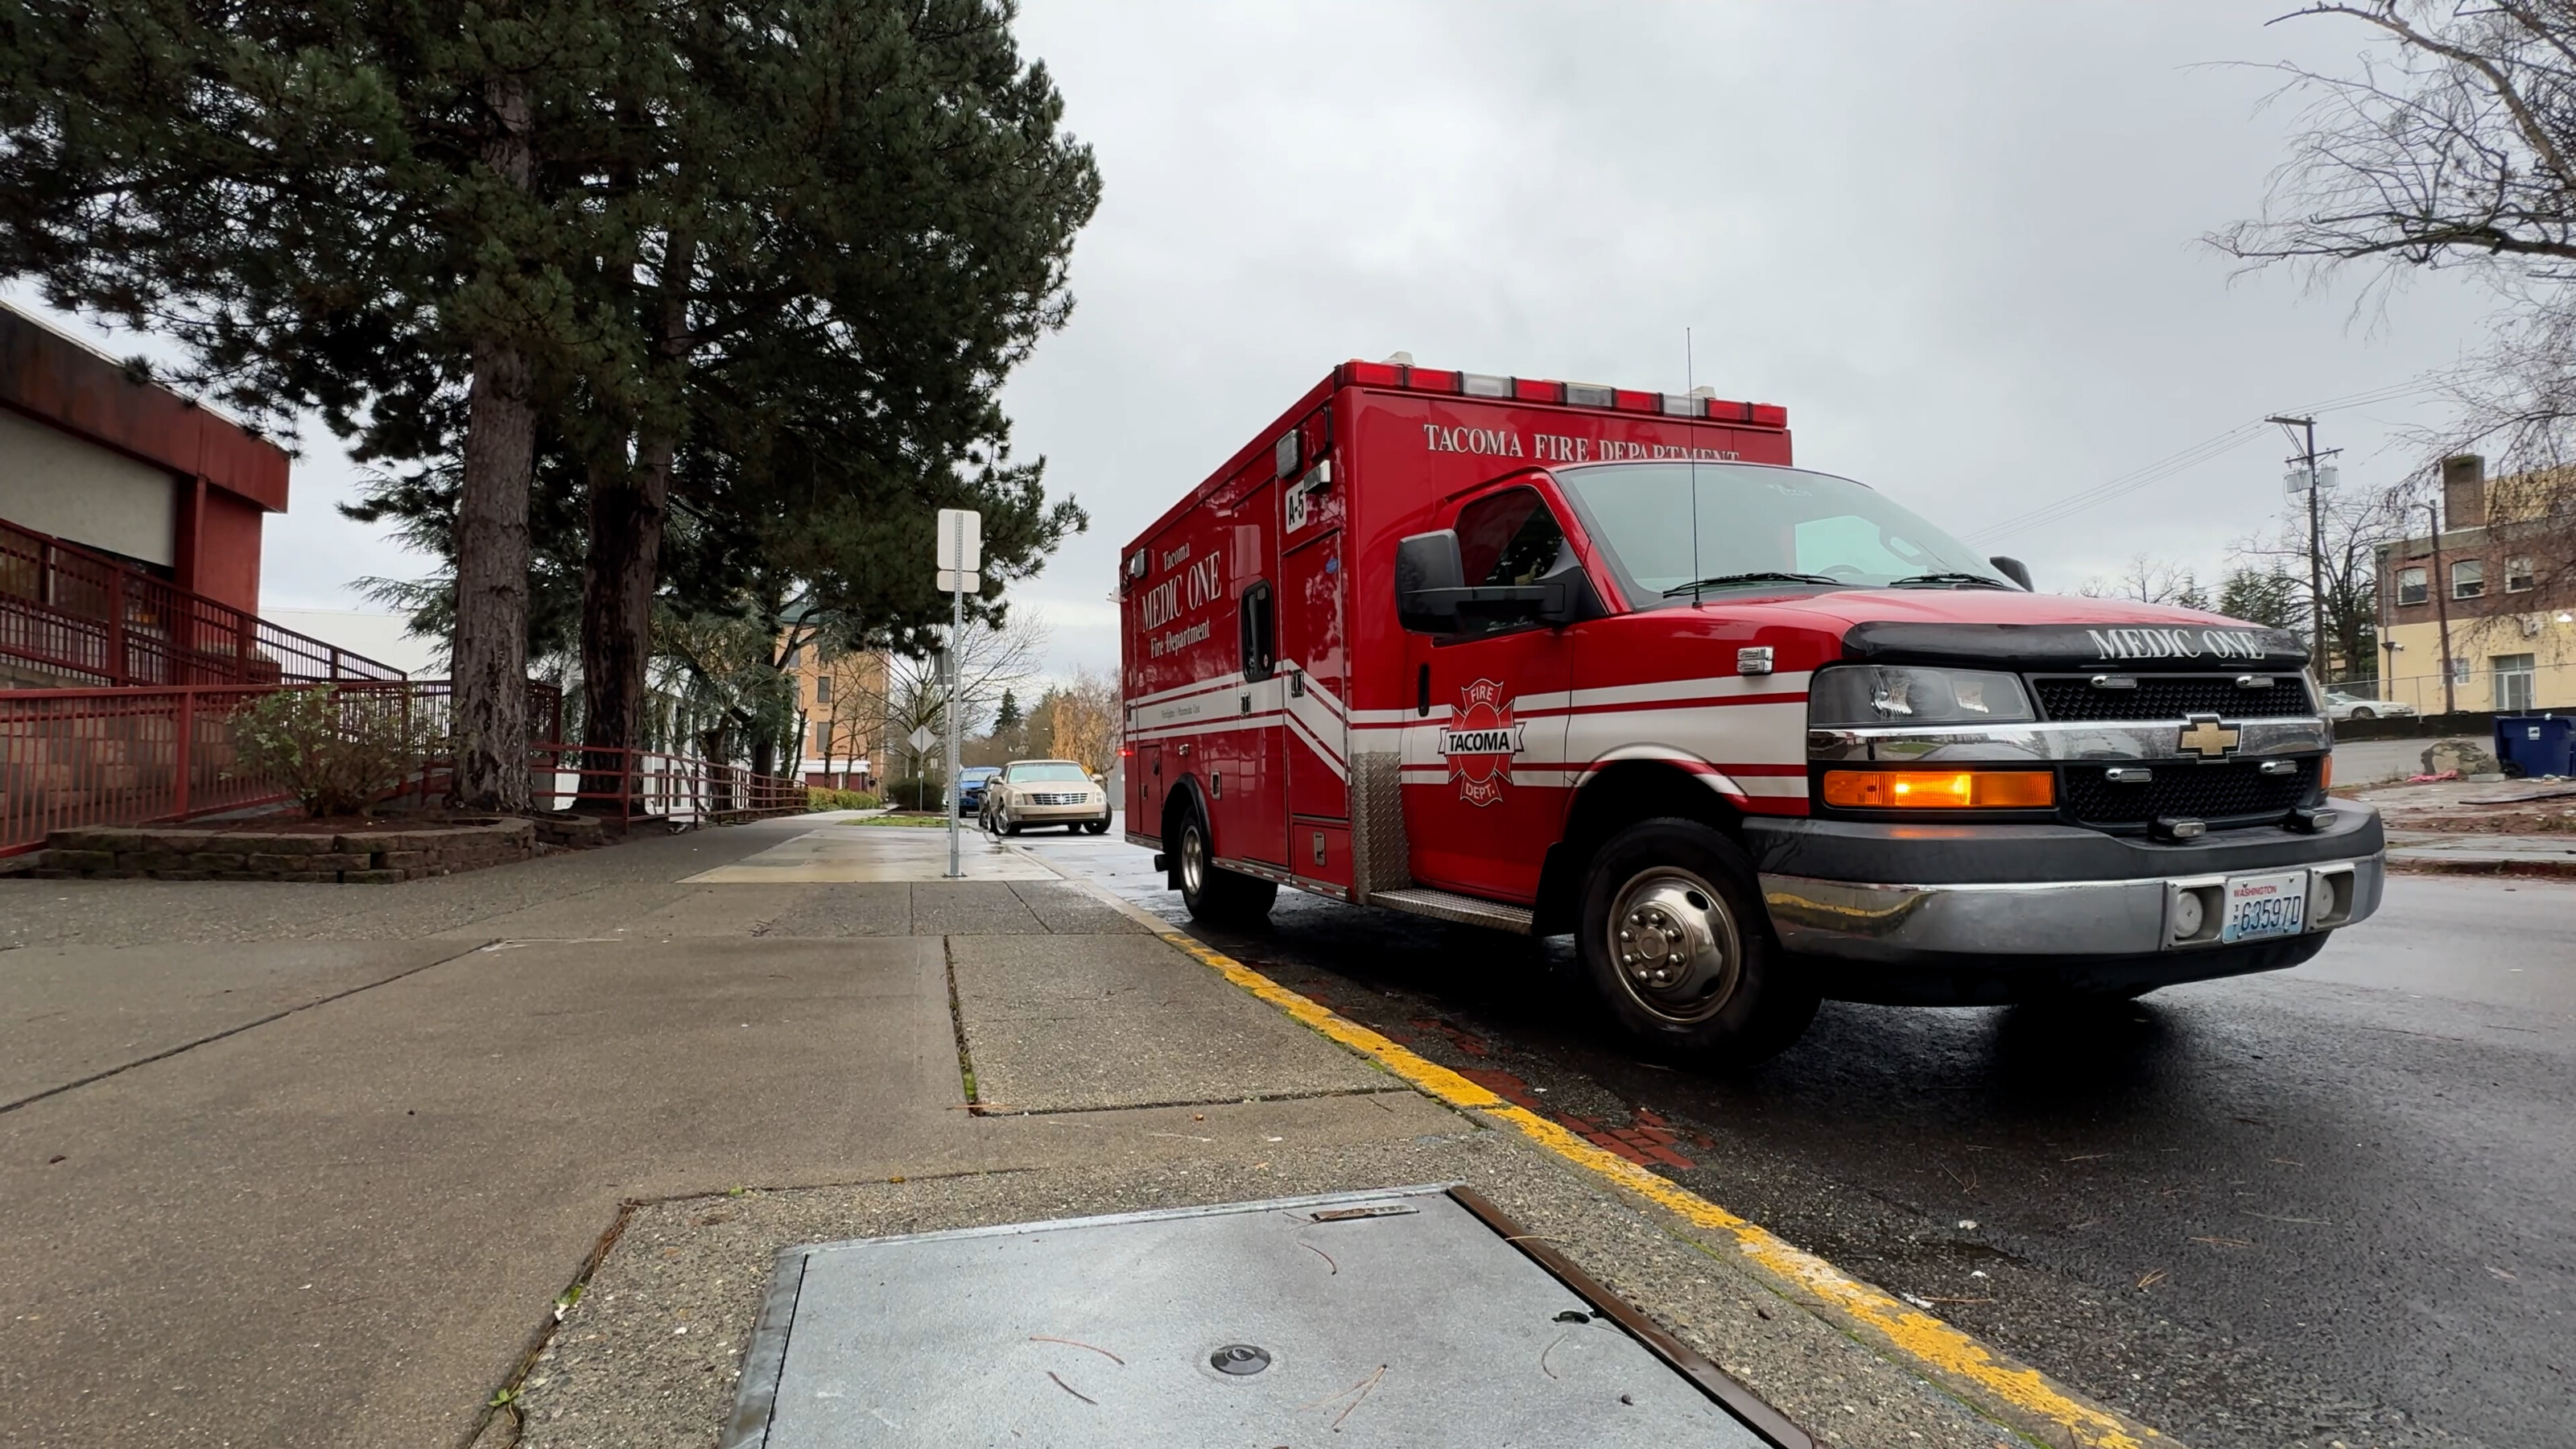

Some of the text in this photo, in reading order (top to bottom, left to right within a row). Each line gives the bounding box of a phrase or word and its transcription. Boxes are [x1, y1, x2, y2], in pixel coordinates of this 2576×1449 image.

[1423, 423, 1524, 458] TACOMA
[1534, 433, 1590, 462] FIRE
[1289, 489, 1304, 525] A-5
[1162, 542, 1190, 572] Tacoma
[1141, 551, 1222, 633] MEDIC ONE
[1150, 616, 1211, 659] Fire Department
[2086, 629, 2265, 660] MEDIC ONE
[1470, 685, 1494, 703] FIRE
[1449, 731, 1510, 752] TACOMA
[1465, 782, 1496, 799] DEPT.
[2233, 886, 2277, 898] WASHINGTON
[2241, 895, 2301, 931] 63597D
